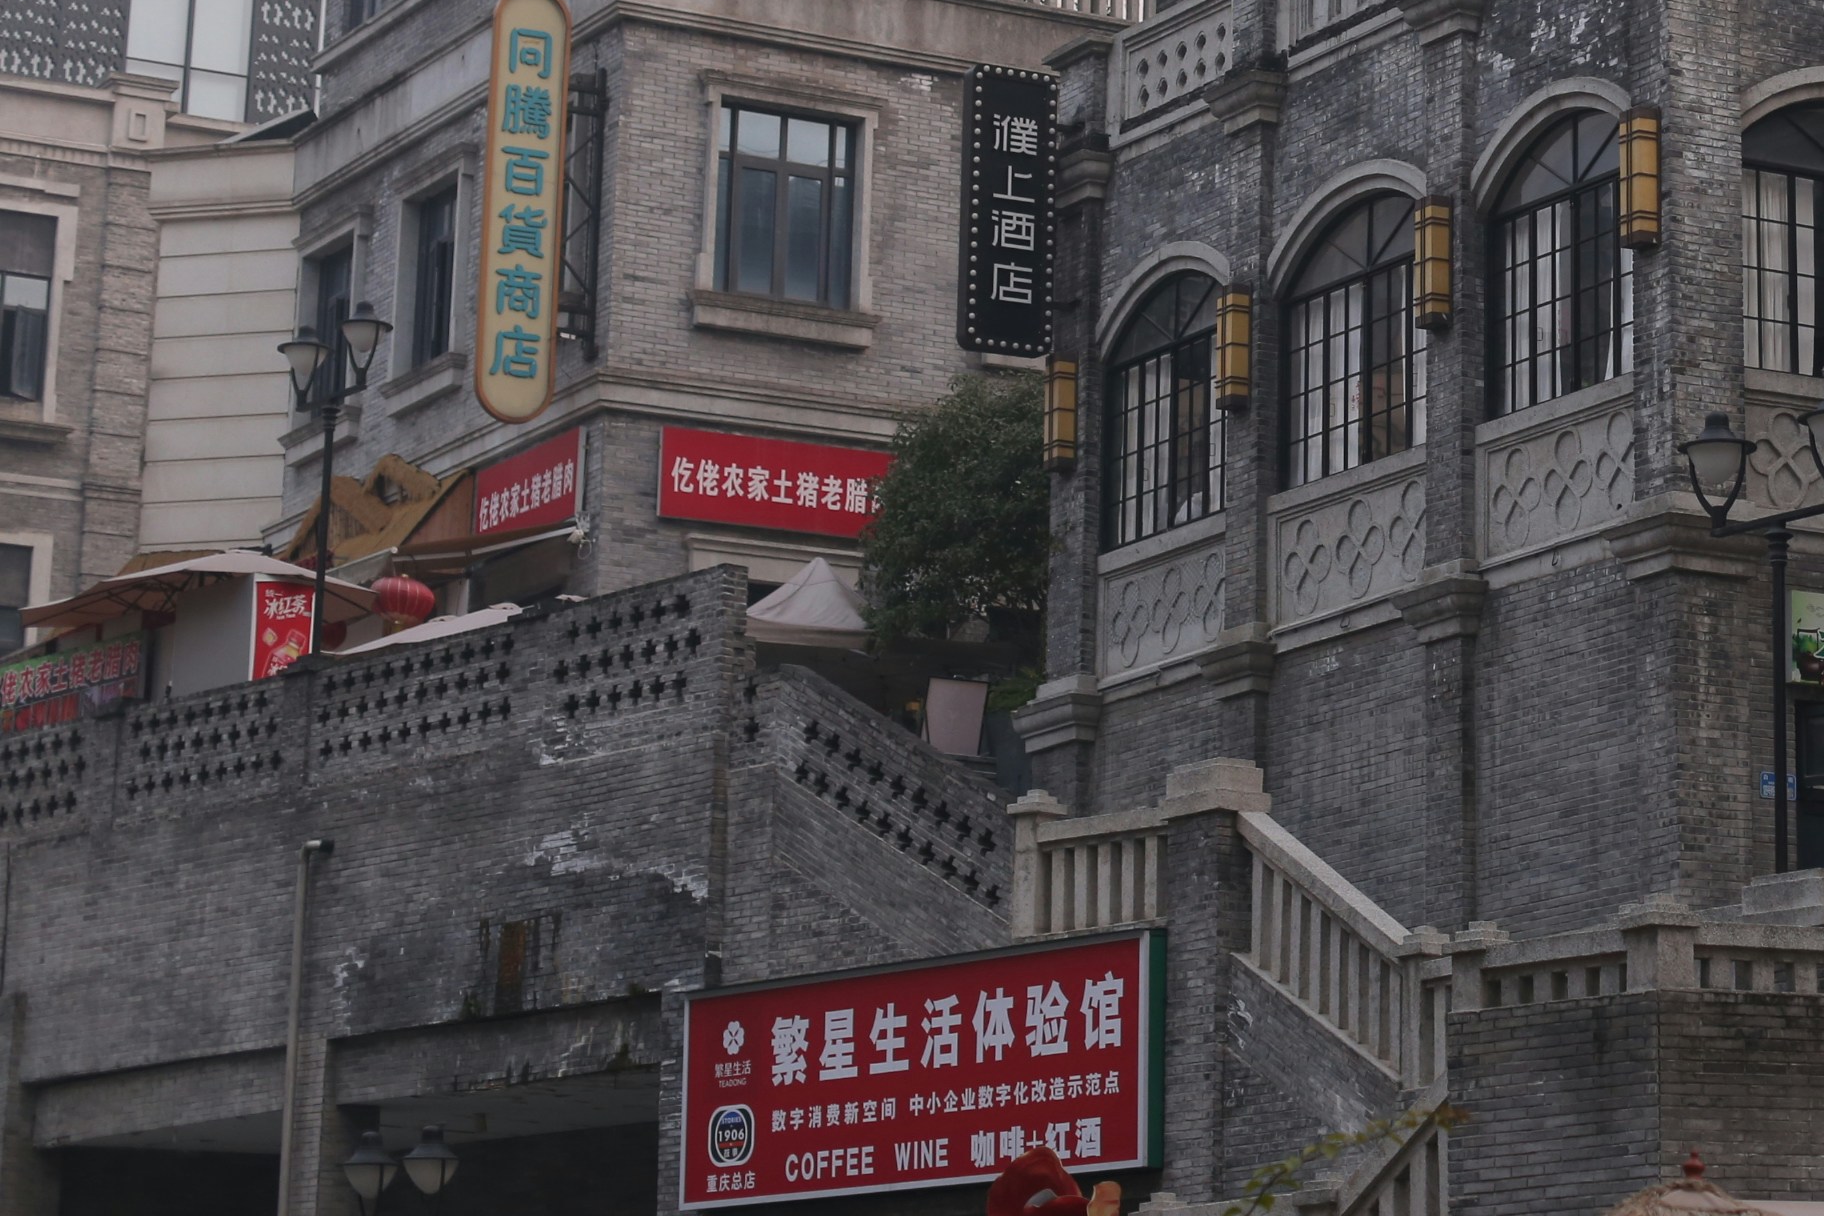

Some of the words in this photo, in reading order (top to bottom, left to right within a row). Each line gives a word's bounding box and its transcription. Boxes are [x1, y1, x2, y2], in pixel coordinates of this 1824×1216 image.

[991, 113, 1038, 305] 濮上酒店
[478, 458, 574, 532] 仡佬农家土猪老腊肉
[264, 595, 307, 619] 冰红茶
[771, 970, 1124, 1086] 繁星生活体验馆
[715, 1060, 752, 1079] 繁星生活
[771, 1098, 896, 1133] 数字消费新空间
[909, 1070, 1120, 1116] 中小企业数字化改造示范点
[718, 1129, 745, 1143] 1906
[785, 1145, 875, 1182] COFFEE
[894, 1138, 949, 1172] WINE
[970, 1117, 1102, 1169] 咖啡+红酒
[706, 1170, 756, 1193] 重庆总店
